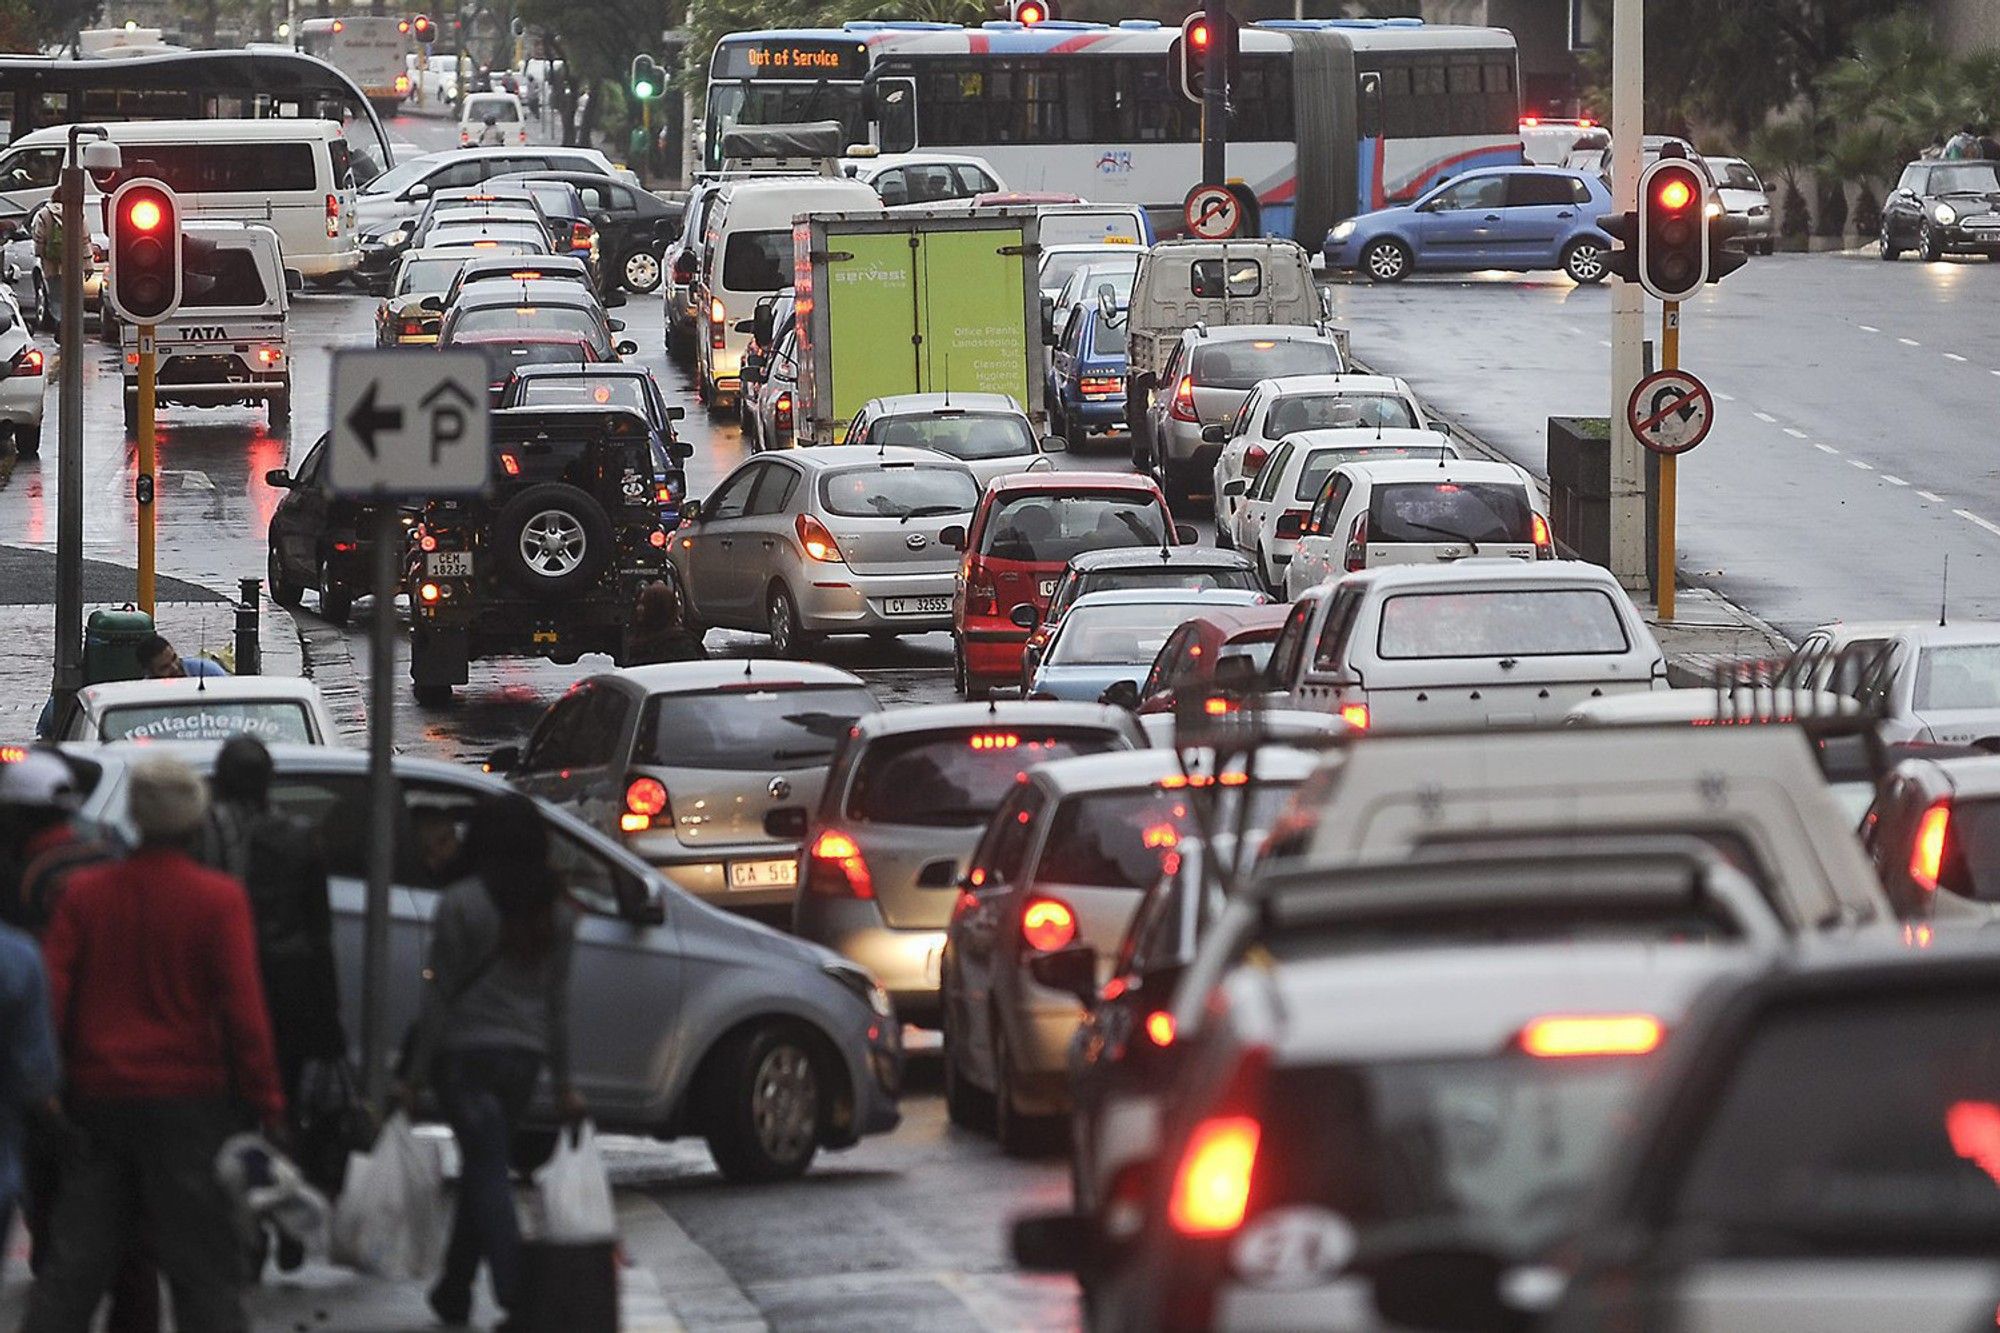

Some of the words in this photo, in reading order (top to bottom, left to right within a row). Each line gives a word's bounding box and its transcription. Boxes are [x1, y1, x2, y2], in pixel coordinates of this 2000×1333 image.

[748, 48, 770, 65] Out
[774, 48, 789, 65] of
[793, 48, 839, 66] Service
[835, 268, 906, 283] servest
[1670, 313, 1677, 326] 2
[178, 326, 228, 340] TATA
[954, 327, 982, 336] Office
[144, 338, 150, 351] 1
[430, 406, 464, 464] P
[438, 553, 460, 564] CEM
[892, 599, 905, 612] CY
[917, 598, 948, 611] 32555
[176, 729, 199, 739] car
[735, 866, 756, 882] CA
[768, 863, 798, 881] 58
